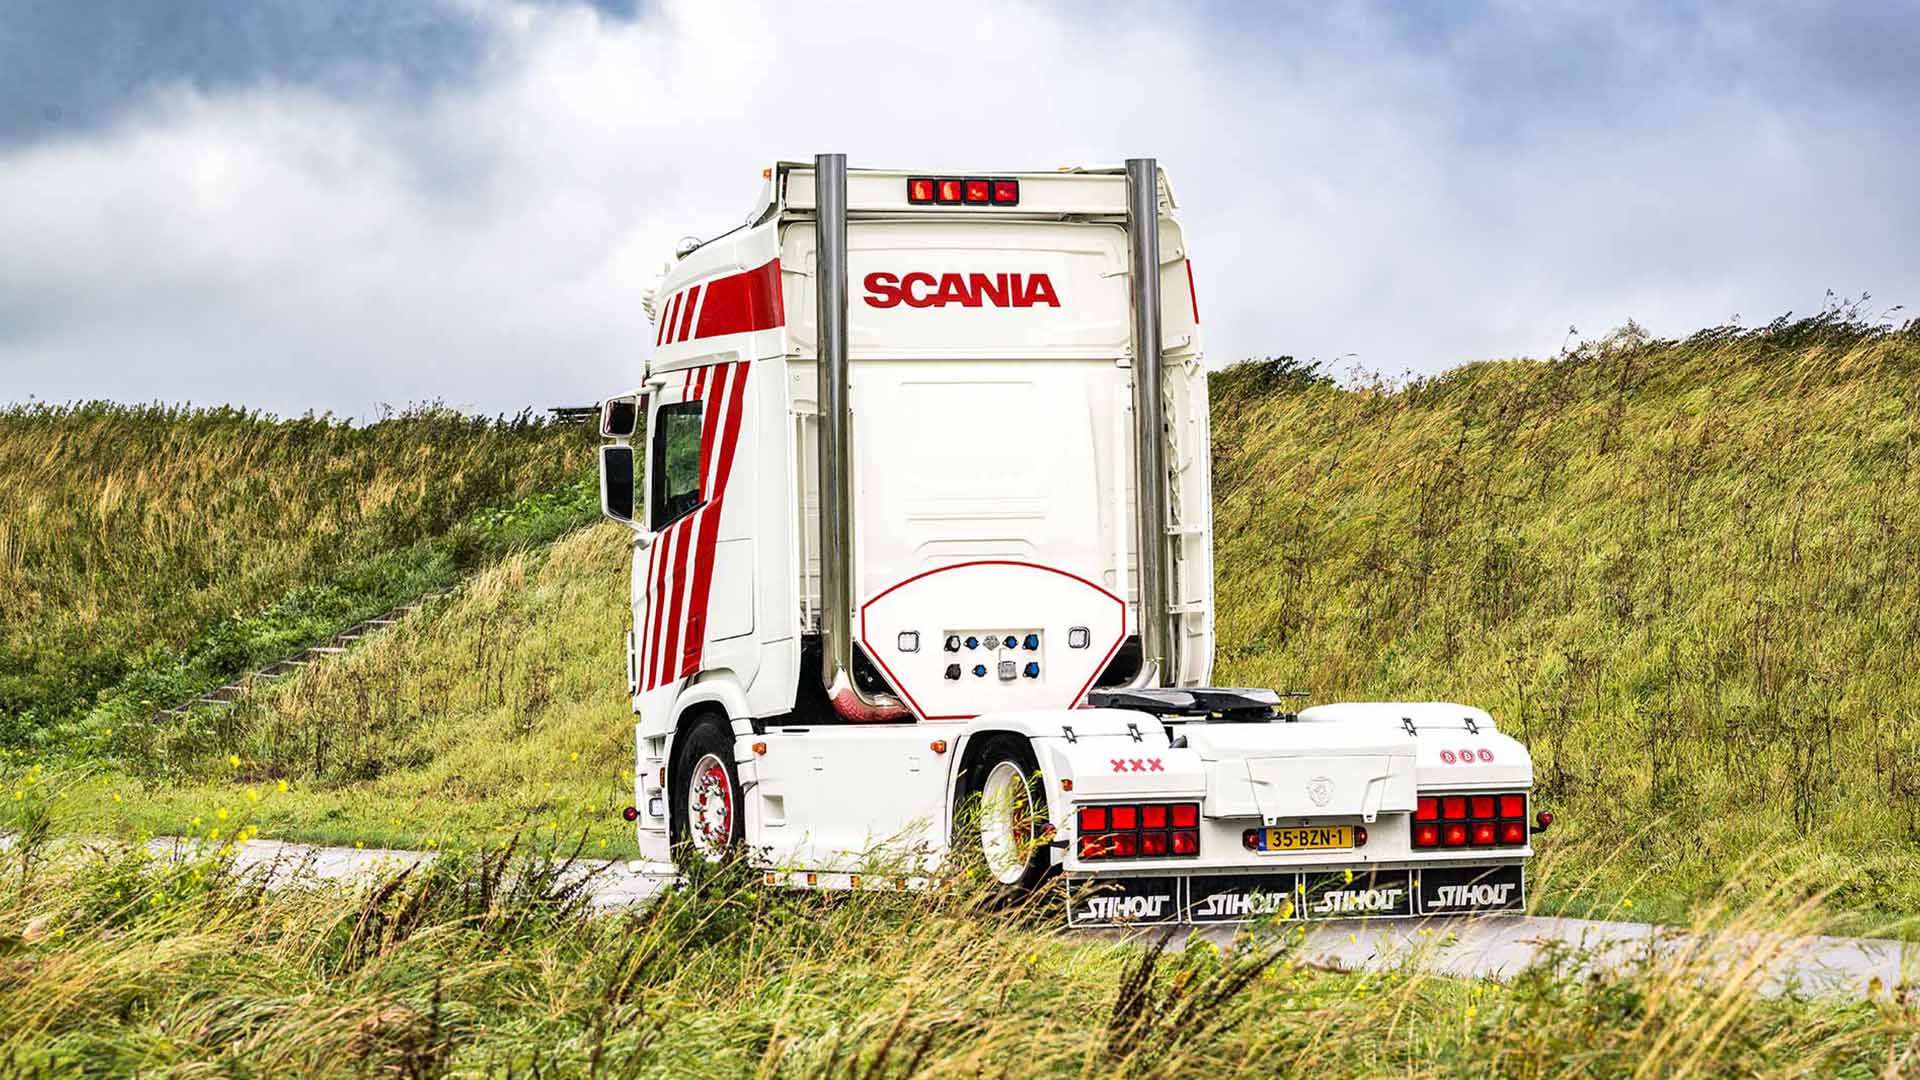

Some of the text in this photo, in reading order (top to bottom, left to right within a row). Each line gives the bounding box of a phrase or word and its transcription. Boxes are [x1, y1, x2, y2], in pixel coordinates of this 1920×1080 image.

[863, 272, 1061, 308] SCANIA
[1272, 829, 1343, 847] 35-BZN-1
[1078, 895, 1170, 919] STIHOLT
[1314, 889, 1402, 912] STIHOLT
[1428, 883, 1516, 907] STIHOLT
